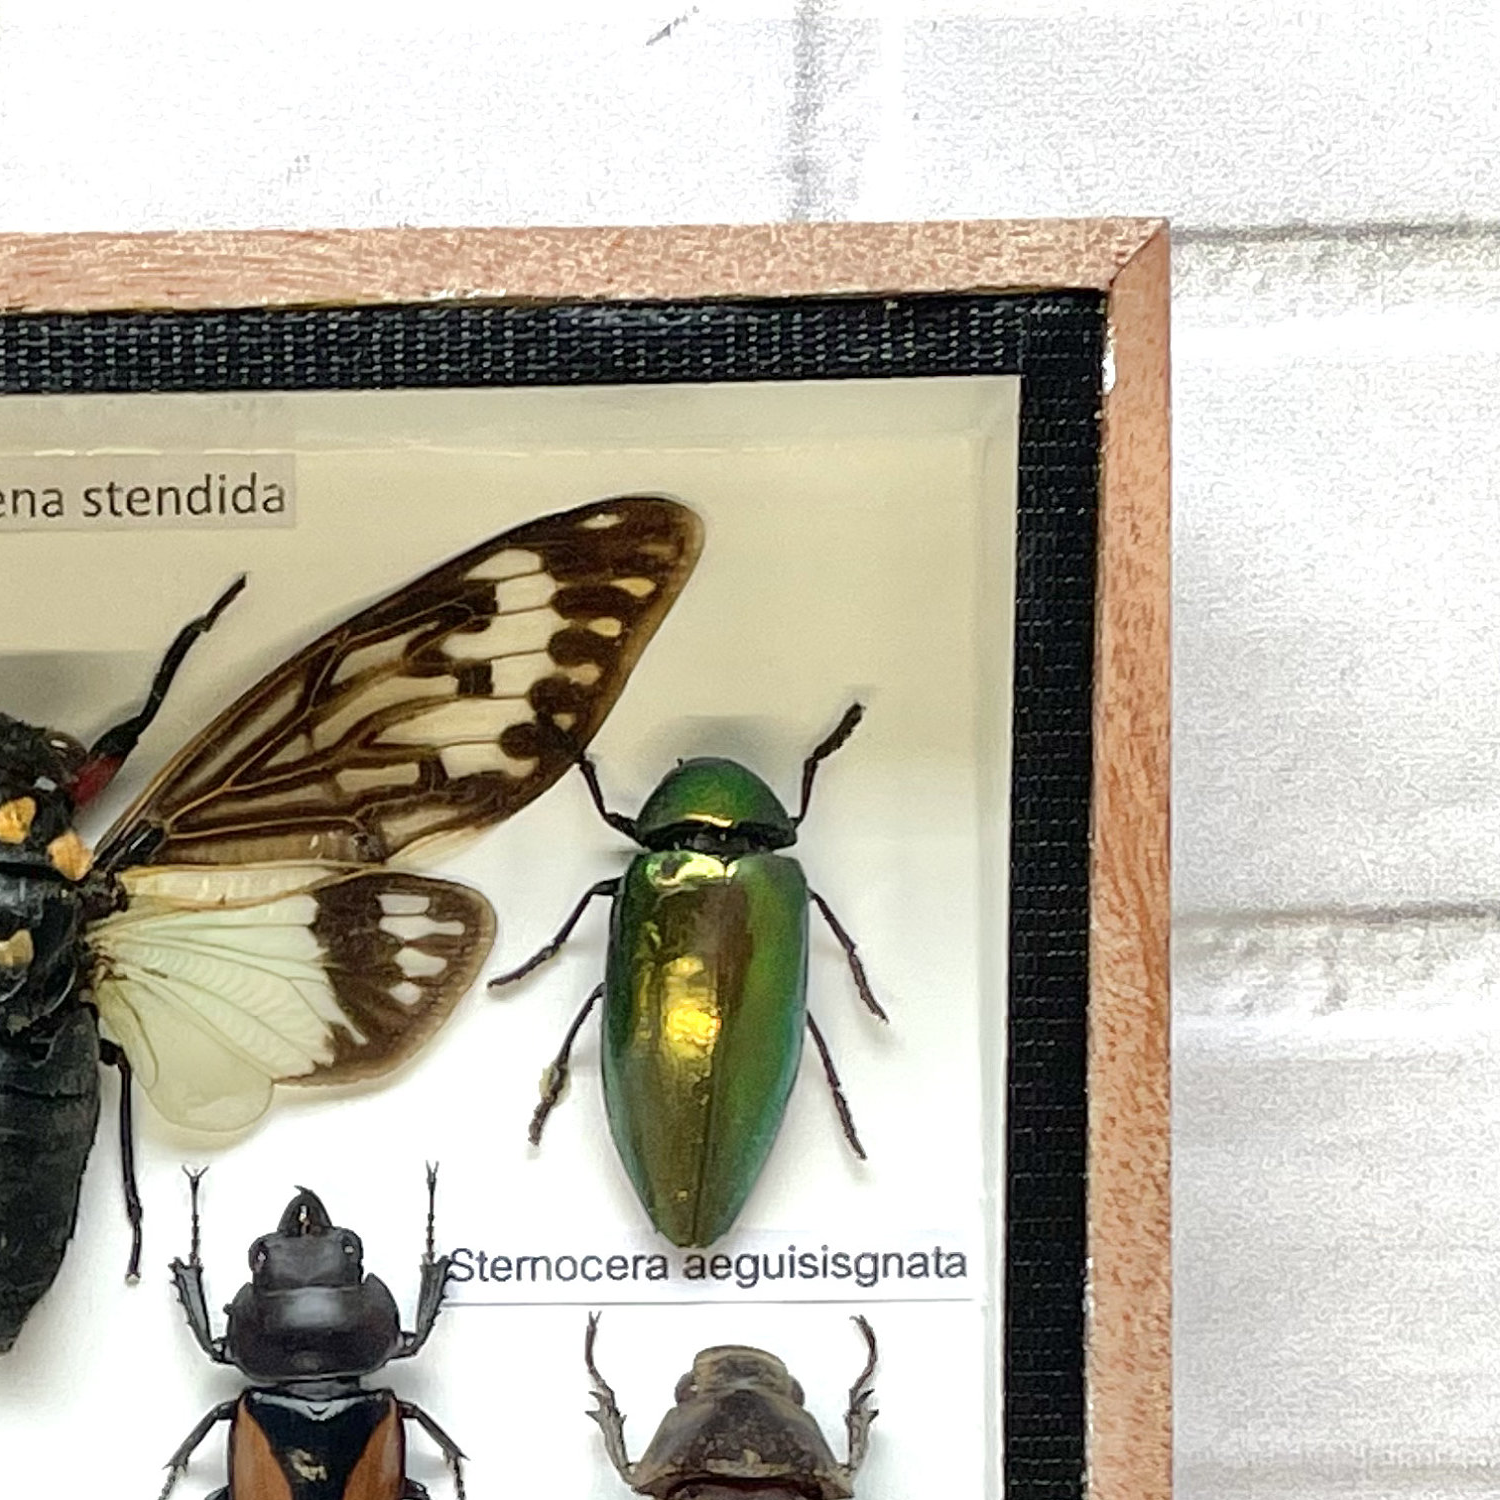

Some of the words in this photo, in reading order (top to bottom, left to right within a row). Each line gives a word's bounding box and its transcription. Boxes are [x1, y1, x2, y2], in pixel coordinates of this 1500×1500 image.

[81, 471, 287, 519] stendida
[448, 1246, 670, 1283] Sternocera
[682, 1244, 968, 1290] aeguisisgnata
